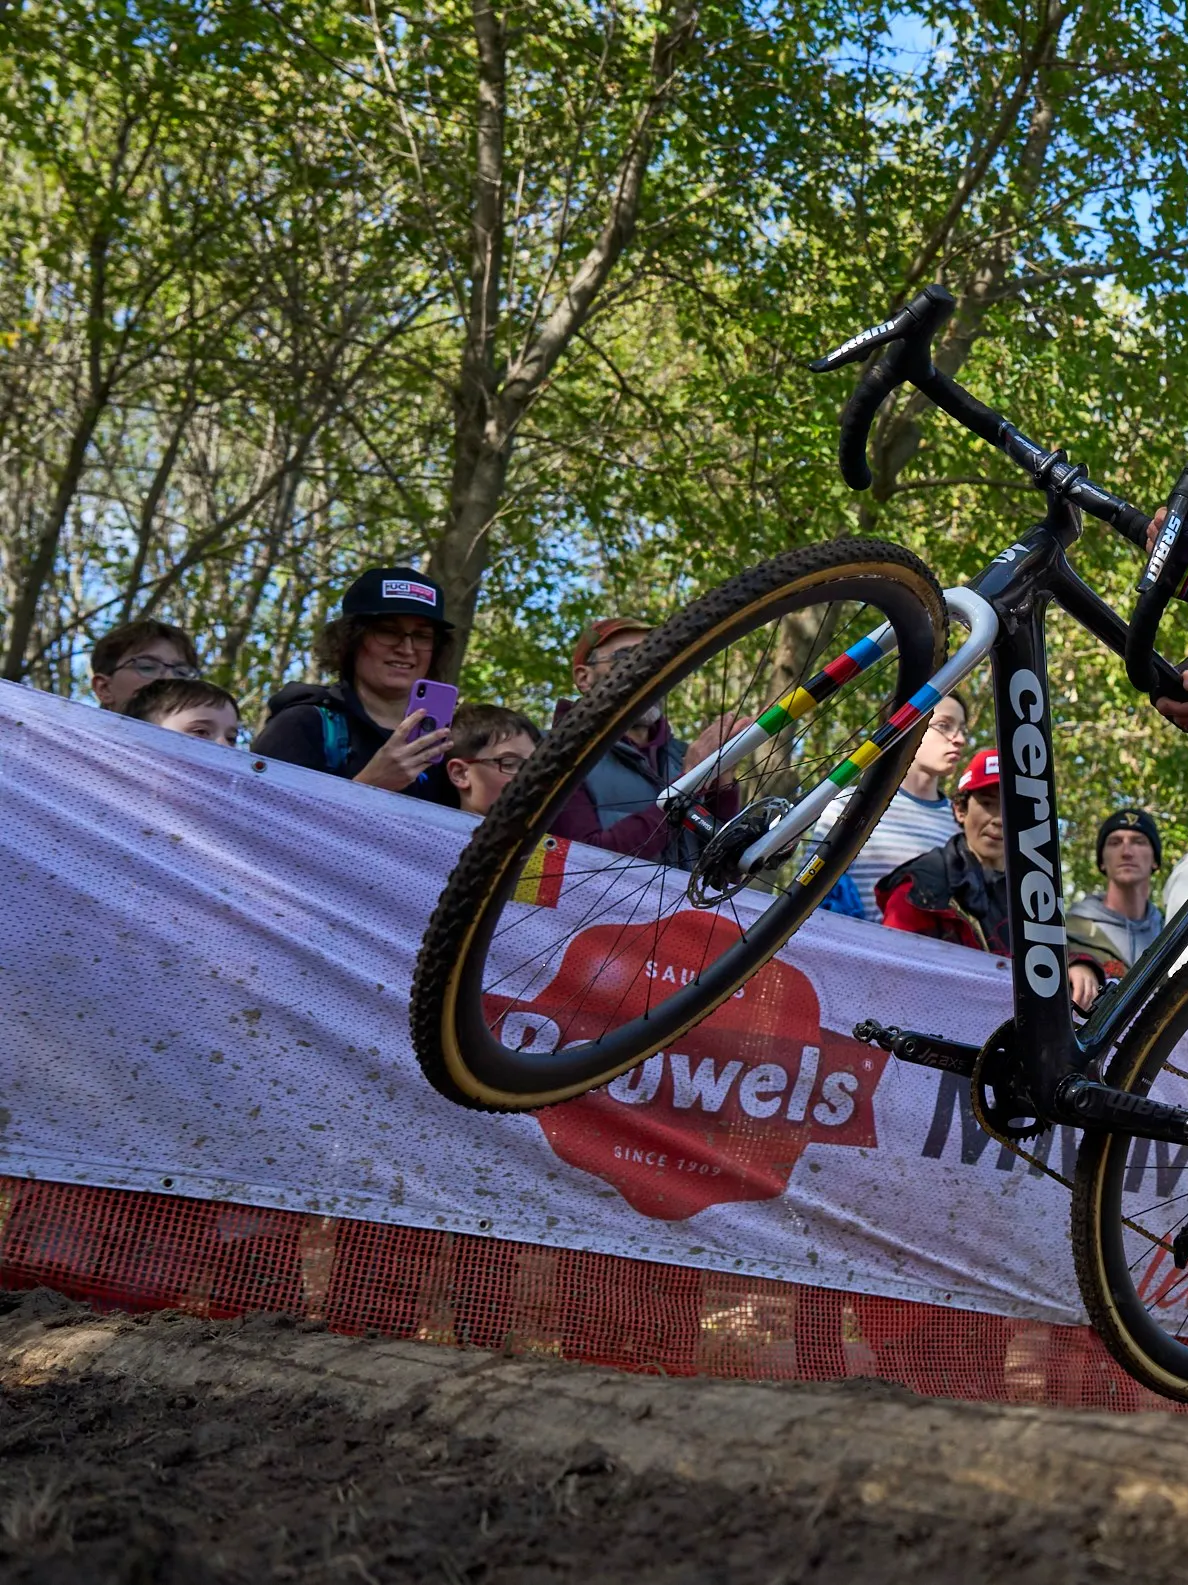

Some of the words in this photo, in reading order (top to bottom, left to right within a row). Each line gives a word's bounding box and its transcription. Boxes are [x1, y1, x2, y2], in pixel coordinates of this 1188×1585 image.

[1146, 515, 1182, 583] SRAM
[500, 1011, 860, 1126] Puwels
[613, 1146, 668, 1168] SINCE
[677, 1159, 722, 1178] 1909
